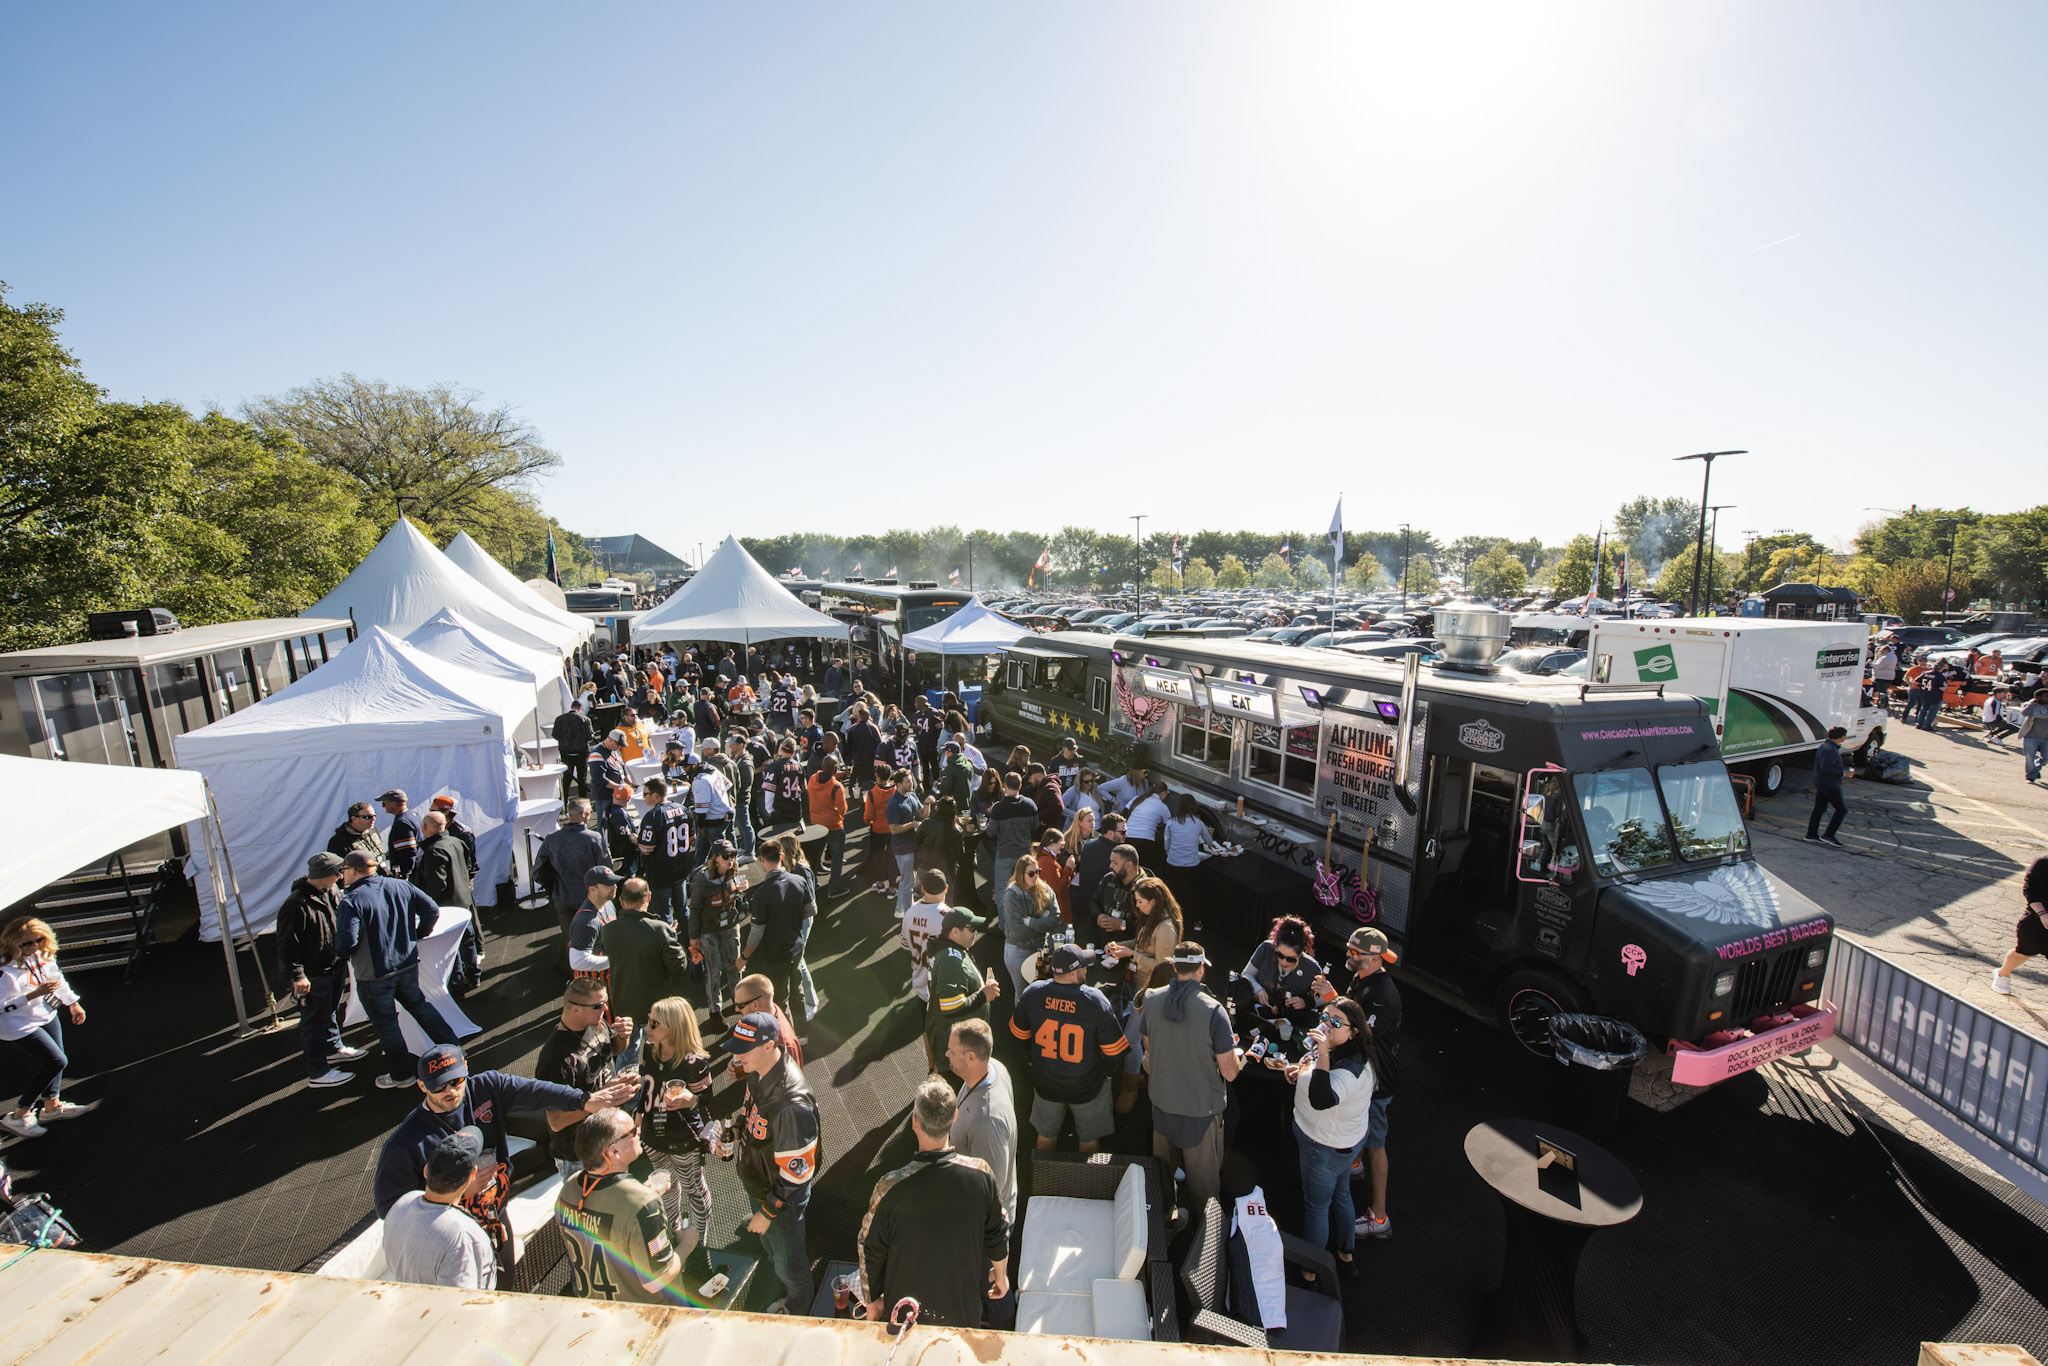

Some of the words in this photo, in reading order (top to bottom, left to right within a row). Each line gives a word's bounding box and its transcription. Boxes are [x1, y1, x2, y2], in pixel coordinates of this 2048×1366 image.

[1819, 651, 1859, 665] enterprise
[1821, 670, 1835, 678] truck
[1836, 668, 1851, 677] rental
[1156, 680, 1180, 694] MEAT
[1921, 679, 1932, 691] 54
[773, 697, 788, 712] 22
[1231, 695, 1251, 711] EAT
[916, 718, 930, 733] 54
[1463, 726, 1501, 739] CHICAGO
[1147, 732, 1162, 743] EAT
[1331, 724, 1394, 758] ACHTUNG
[1462, 736, 1500, 749] KITCHEN
[1724, 738, 1774, 751] enterprisetrucks.com
[894, 748, 912, 768] 52
[1326, 751, 1355, 770] FRESH
[1356, 758, 1396, 782] BURGER
[782, 775, 800, 799] 34
[1334, 771, 1361, 792] BEING
[1362, 778, 1391, 801] MADE
[1341, 792, 1378, 816] ONSITE!
[642, 829, 653, 842] 89
[667, 822, 690, 857] 89
[1254, 829, 1299, 866] ROCK
[913, 916, 928, 928] MACK
[1715, 936, 1763, 960] WORLDS
[1762, 929, 1788, 950] BEST
[1789, 918, 1828, 942] BURGER
[947, 947, 962, 961] 12
[1625, 947, 1644, 958] CCK
[1045, 996, 1076, 1014] SAYERS
[1035, 1018, 1085, 1064] 40
[1727, 1048, 1750, 1064] ROCK
[1751, 1040, 1774, 1055] ROCK
[1775, 1035, 1788, 1046] TILL
[1791, 1030, 1799, 1040] YA
[428, 1056, 458, 1074] Bears
[1727, 1058, 1749, 1074] ROCK
[1751, 1050, 1773, 1065] ROCK
[1774, 1043, 1797, 1057] NEVER
[562, 1206, 601, 1235] PAYTON
[562, 1229, 620, 1300] 34
